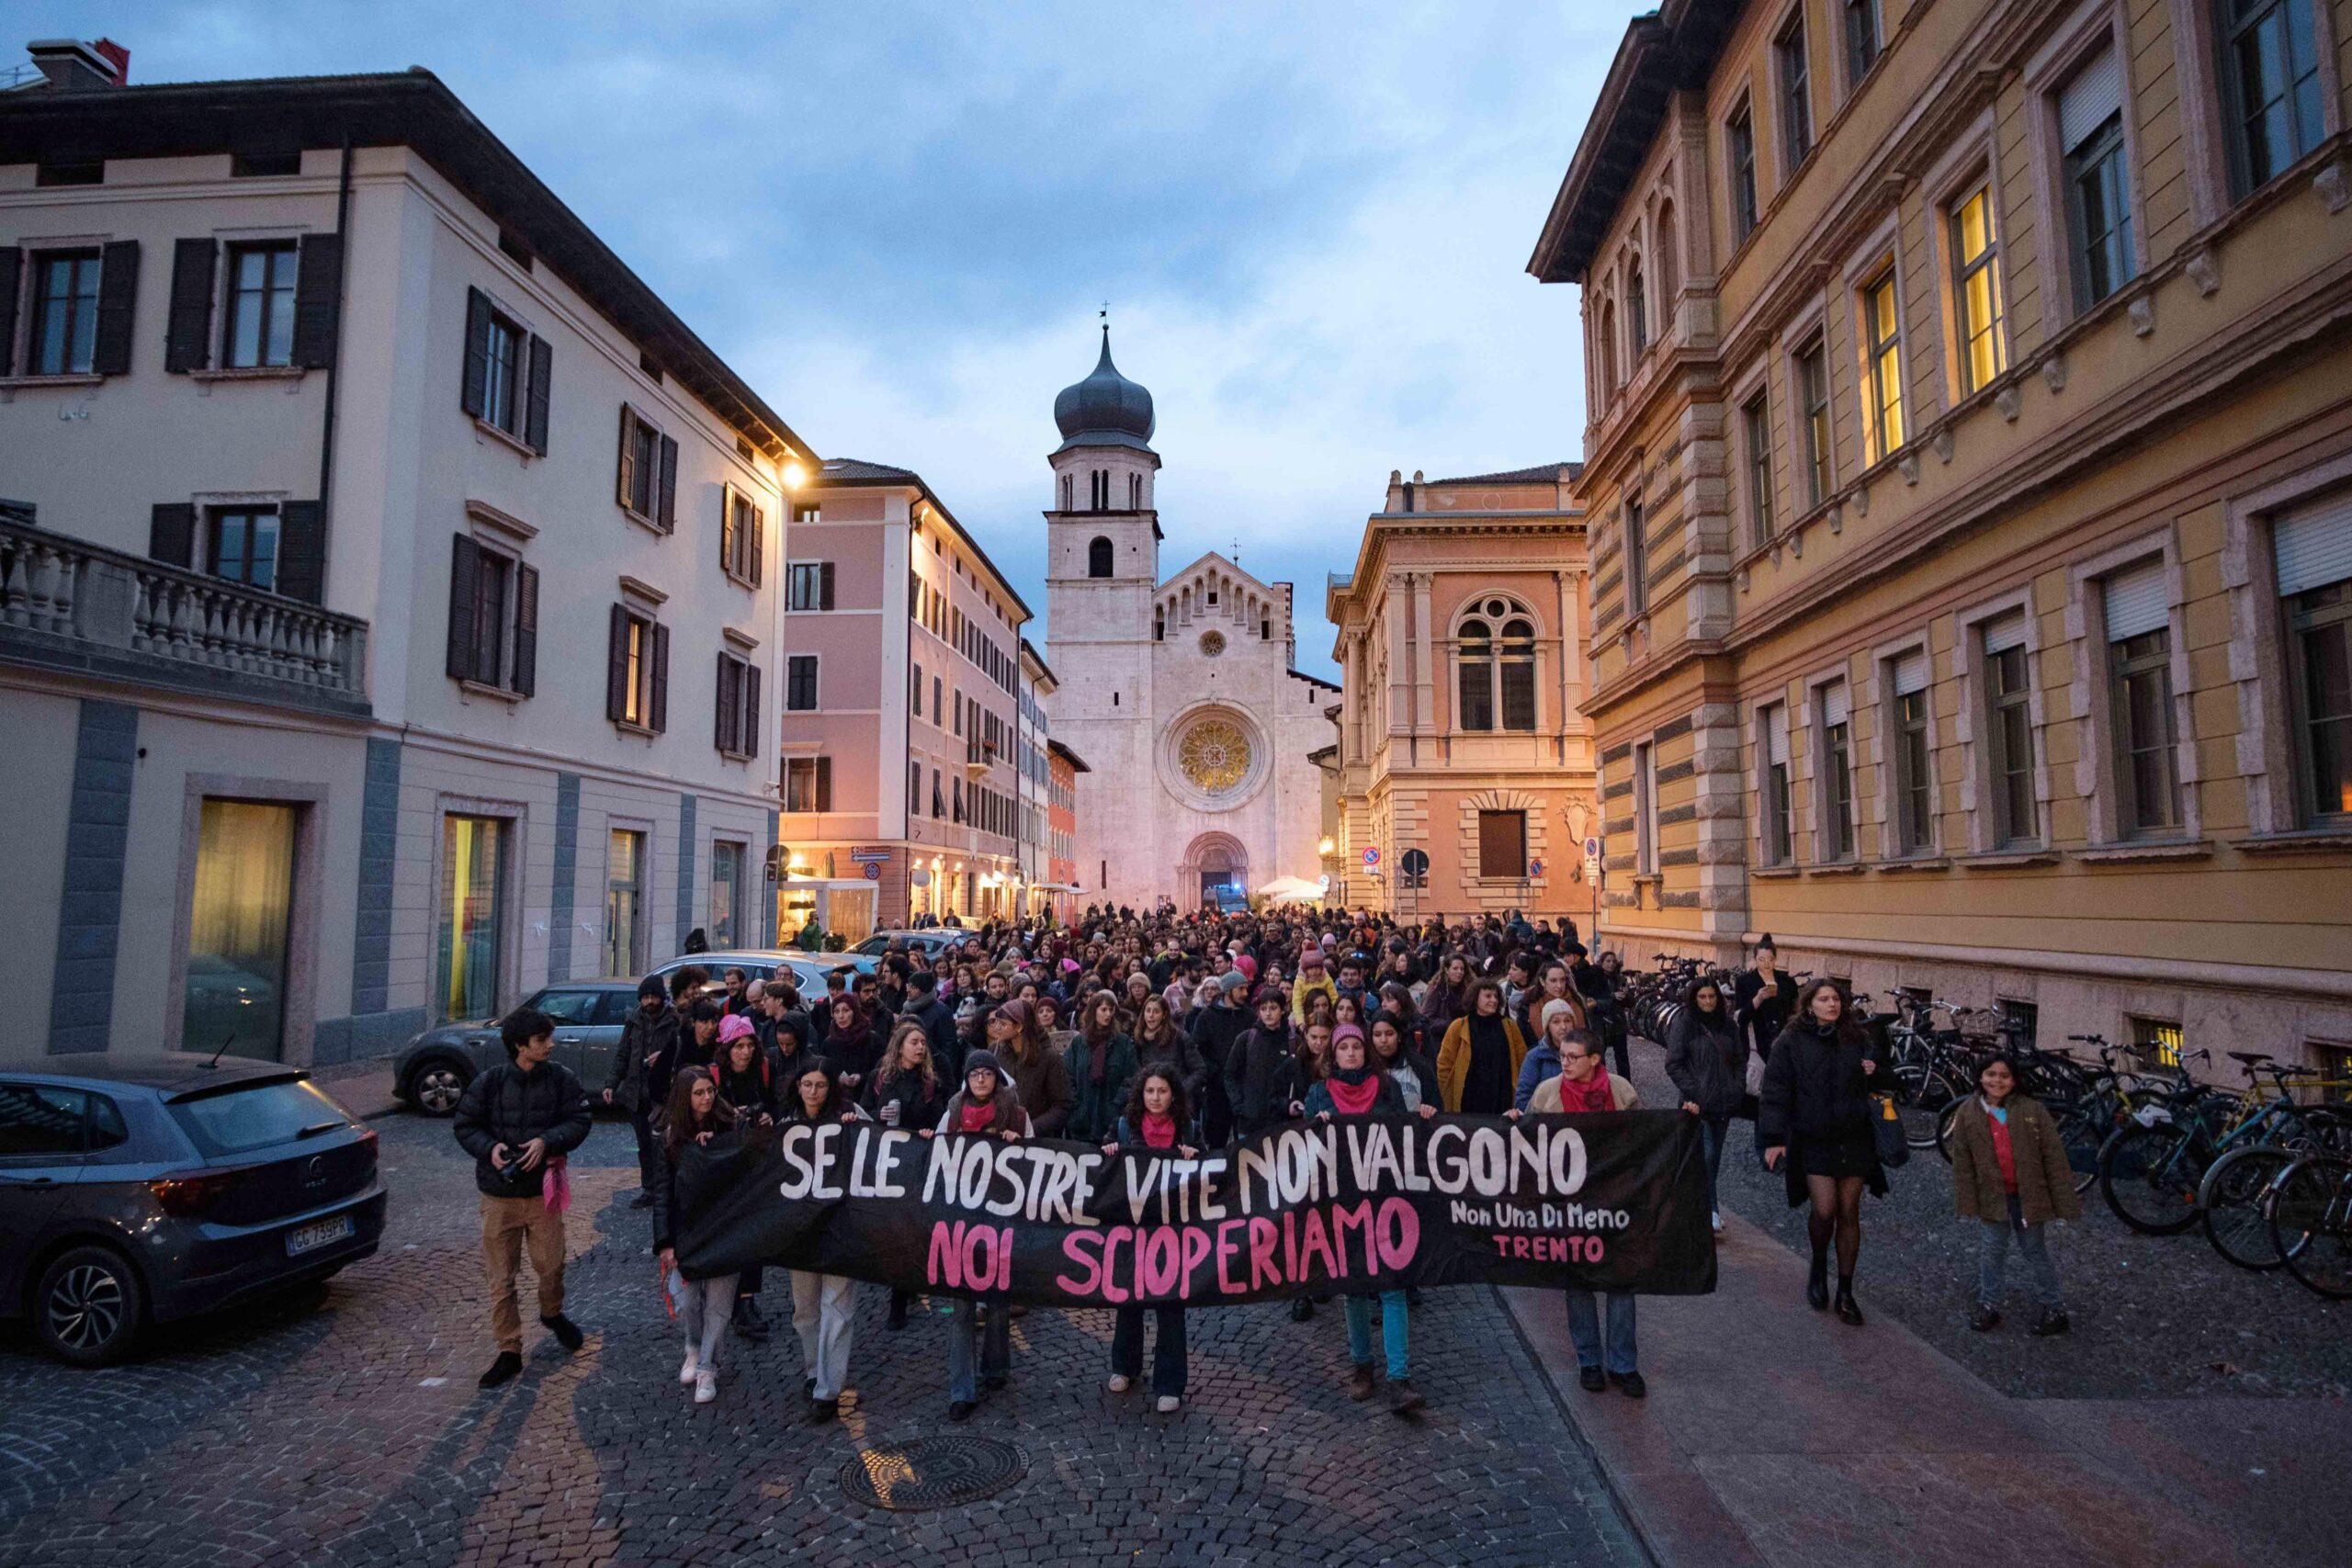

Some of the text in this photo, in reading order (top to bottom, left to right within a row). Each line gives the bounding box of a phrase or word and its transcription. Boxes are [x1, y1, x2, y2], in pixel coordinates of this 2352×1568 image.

[780, 1123, 1588, 1226] SE LE NOSTRE VITE NON VALGONO
[1451, 1200, 1491, 1226] Non
[1495, 1201, 1538, 1228] Una
[1566, 1202, 1630, 1230] Meno
[927, 1197, 1420, 1303] NOI SCIOPERIAMO
[1492, 1235, 1604, 1263] TRENTO
